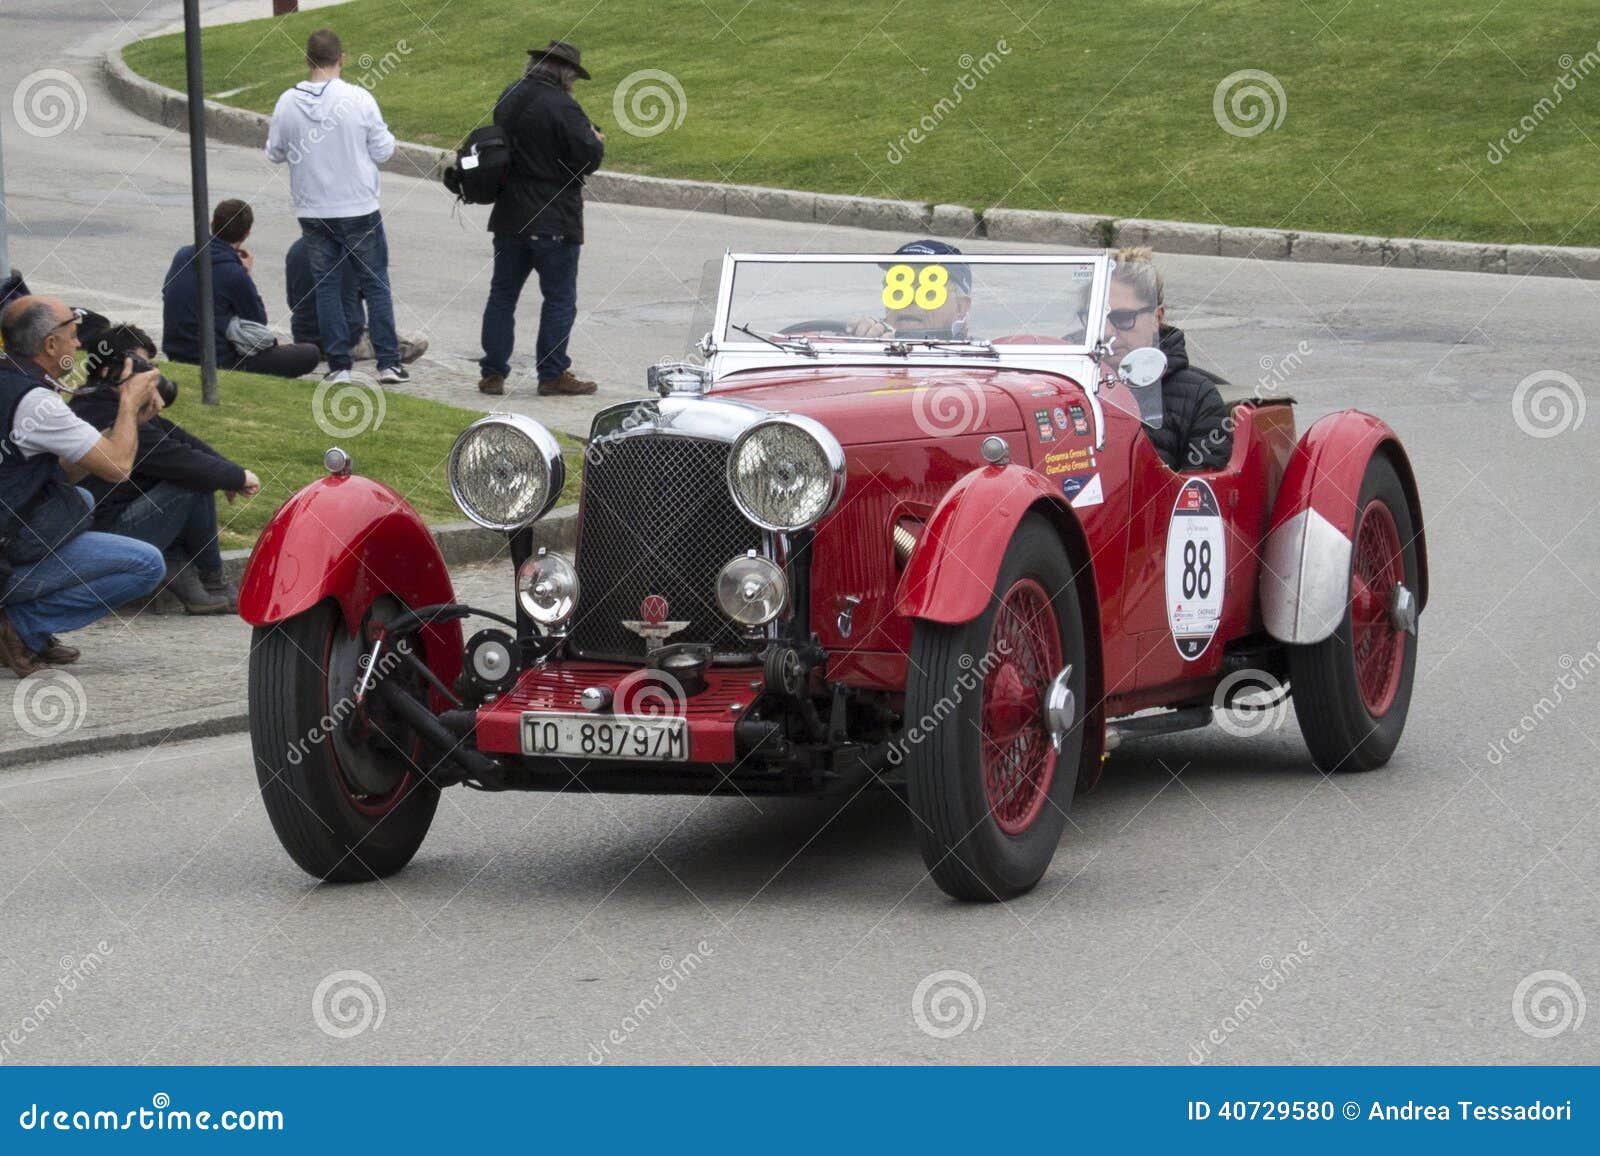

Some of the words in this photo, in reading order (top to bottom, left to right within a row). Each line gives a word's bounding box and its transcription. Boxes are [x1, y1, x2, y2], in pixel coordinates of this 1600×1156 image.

[882, 264, 949, 311] 88
[1183, 540, 1212, 600] 88
[526, 720, 559, 752] TO
[580, 723, 684, 759] 89797M
